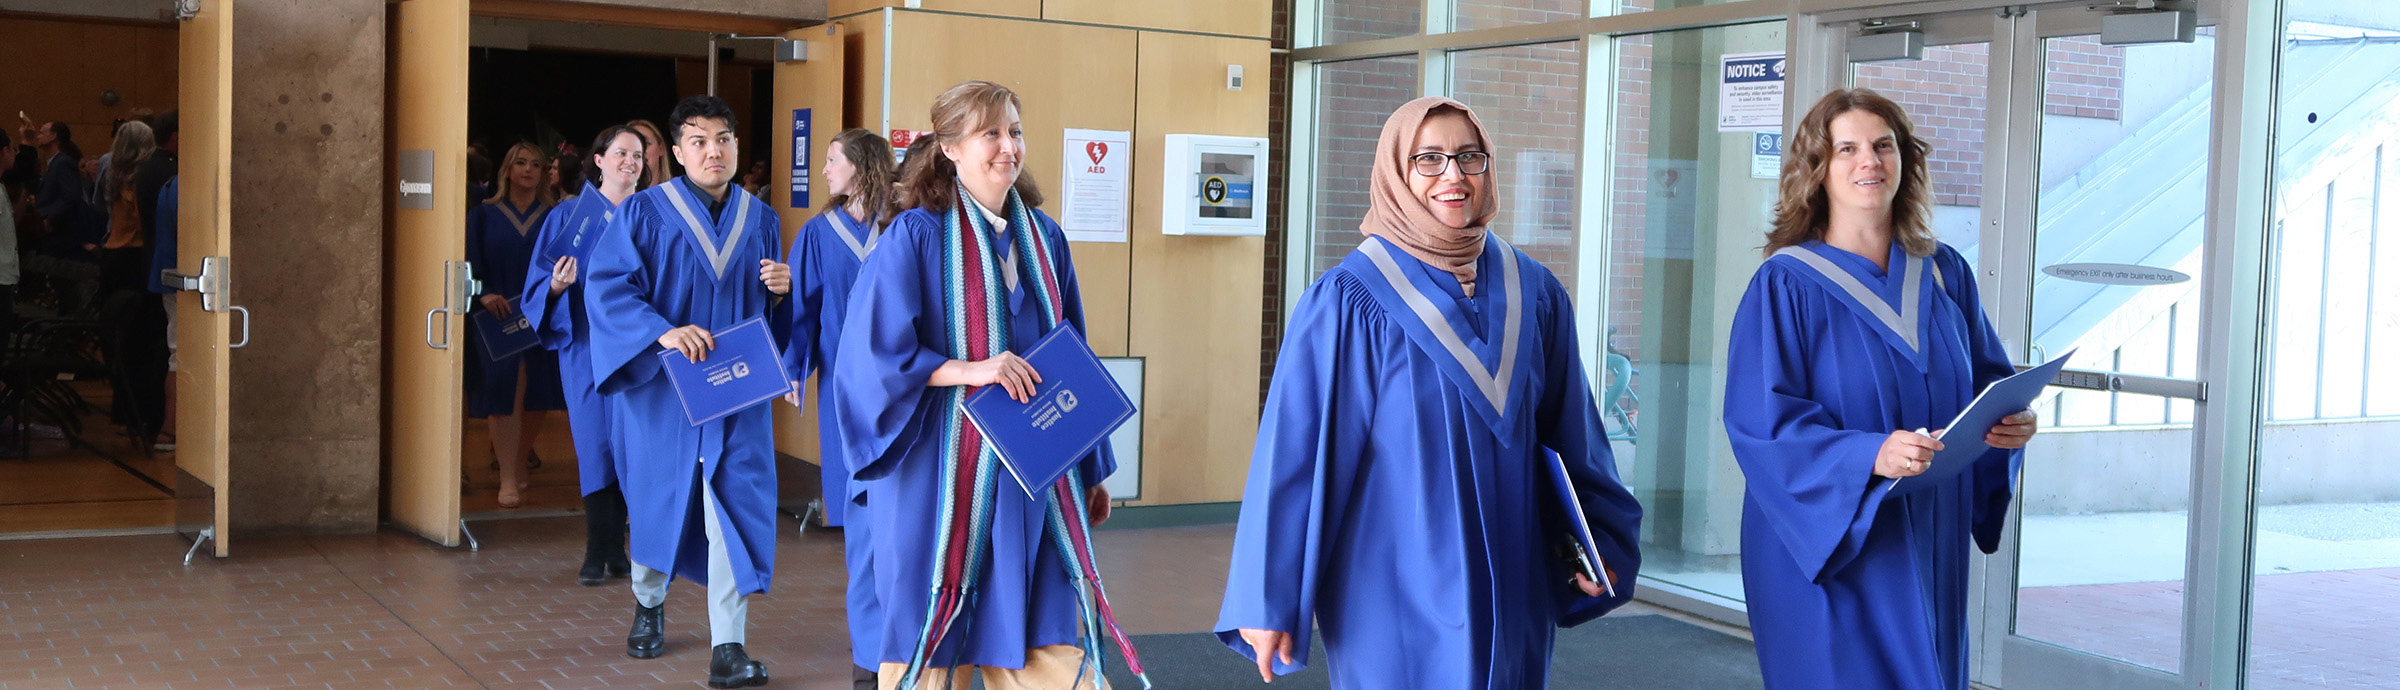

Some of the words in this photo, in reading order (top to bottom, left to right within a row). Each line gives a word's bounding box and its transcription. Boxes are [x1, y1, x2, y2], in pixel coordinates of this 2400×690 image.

[1727, 63, 1766, 78] NOTICE
[1087, 166, 1105, 174] AED
[1208, 181, 1222, 189] AED
[2056, 267, 2089, 278] Emergency
[2102, 271, 2114, 279] only
[2130, 272, 2155, 280] business
[1031, 405, 1057, 428] Institute
[1040, 411, 1062, 431] Justice
